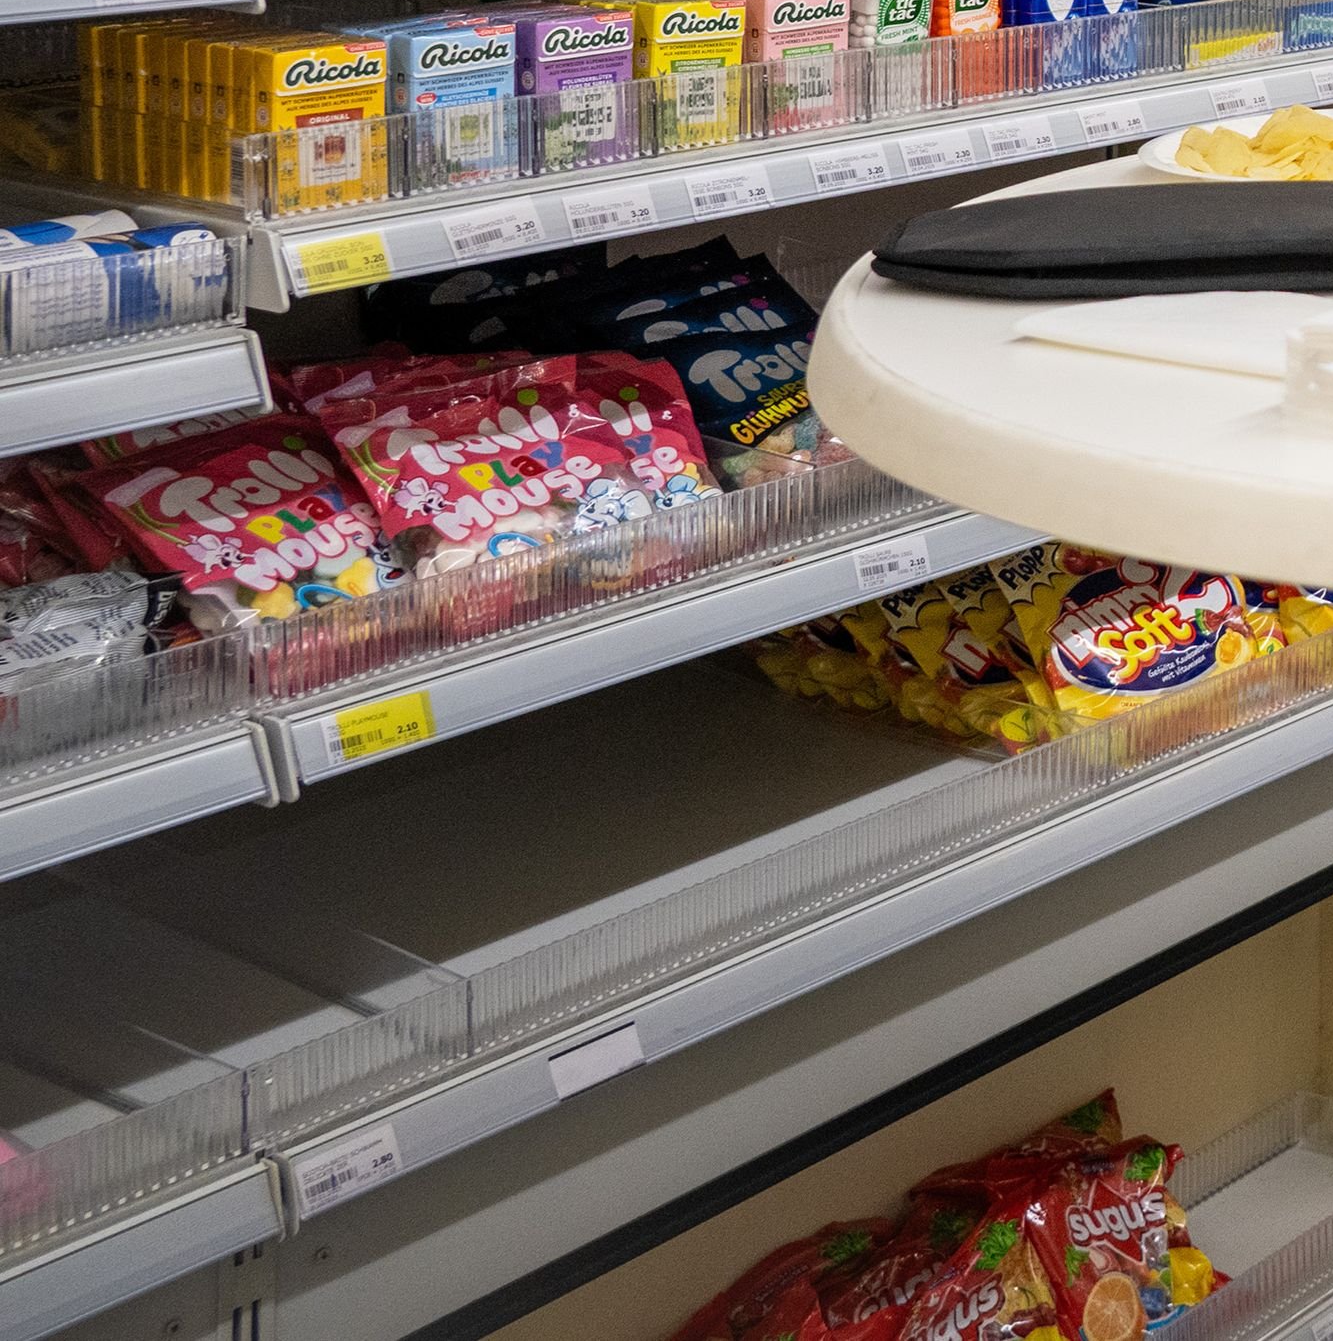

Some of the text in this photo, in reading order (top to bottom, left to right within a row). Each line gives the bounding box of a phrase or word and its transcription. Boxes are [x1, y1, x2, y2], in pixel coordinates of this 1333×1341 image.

[773, 0, 845, 25] Ricola
[888, 8, 916, 22] tac
[662, 11, 740, 36] Ricola
[902, 27, 918, 36] MINT
[544, 25, 627, 53] Ricola
[420, 38, 509, 69] Ricola
[285, 55, 380, 87] Ricola
[308, 112, 350, 125] ORIGINAL
[1036, 135, 1051, 145] 2.30
[955, 149, 971, 160] 2.30
[866, 165, 884, 176] 3.20
[748, 187, 766, 198] 3.20
[630, 207, 650, 219] 3.20
[515, 220, 536, 233] 3.20
[363, 253, 385, 266] 3.20
[387, 404, 560, 476] Trolli
[160, 449, 335, 533] Trolli
[909, 557, 926, 567] 2.10
[396, 721, 419, 734] 2.10
[1067, 1191, 1166, 1242] sugus
